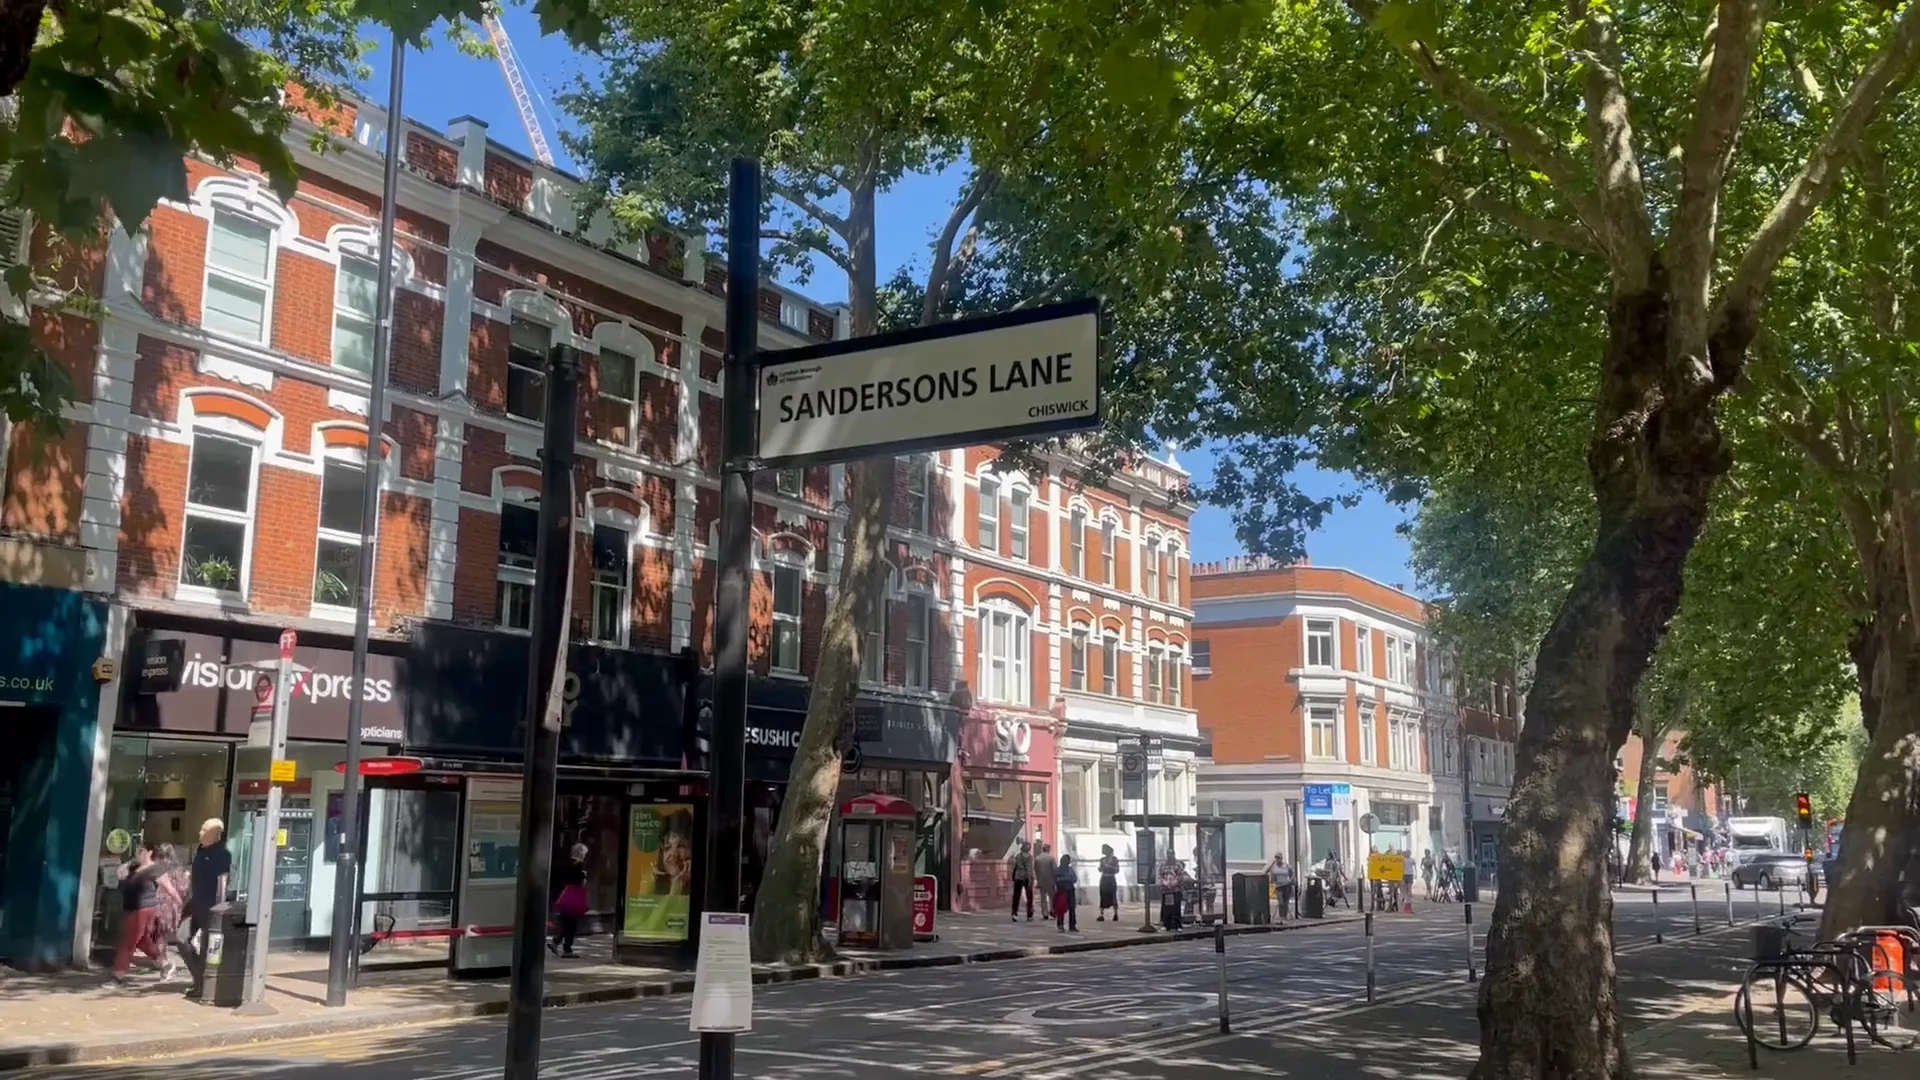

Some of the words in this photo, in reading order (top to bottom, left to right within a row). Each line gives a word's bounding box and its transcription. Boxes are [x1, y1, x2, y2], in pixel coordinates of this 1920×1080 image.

[779, 367, 978, 423] SANDERSONS
[989, 352, 1072, 393] LANE
[1028, 399, 1088, 418] CHISWICK
[146, 654, 167, 665] vision
[141, 666, 169, 678] express
[751, 727, 789, 747] SUSHI
[996, 718, 1031, 755] SO
[1306, 786, 1317, 794] To
[1318, 786, 1331, 794] Let
